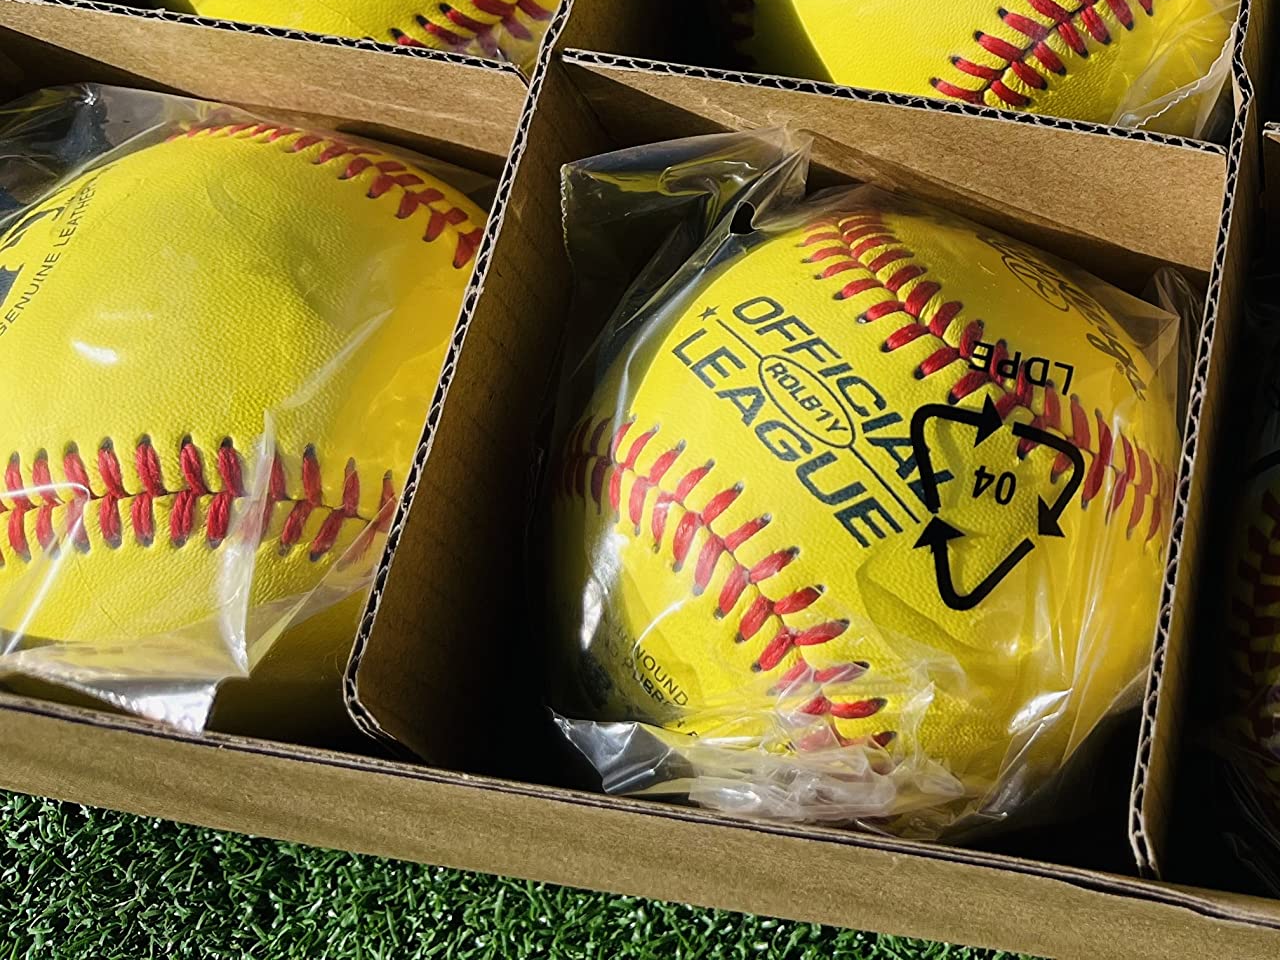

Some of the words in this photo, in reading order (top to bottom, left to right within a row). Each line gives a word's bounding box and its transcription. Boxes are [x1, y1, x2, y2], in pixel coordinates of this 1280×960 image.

[732, 296, 954, 507] OFFICIAL
[765, 362, 849, 434] ROLB1Y
[968, 340, 1075, 396] LDPE
[671, 328, 904, 549] LEAGUE
[974, 469, 1016, 505] 04
